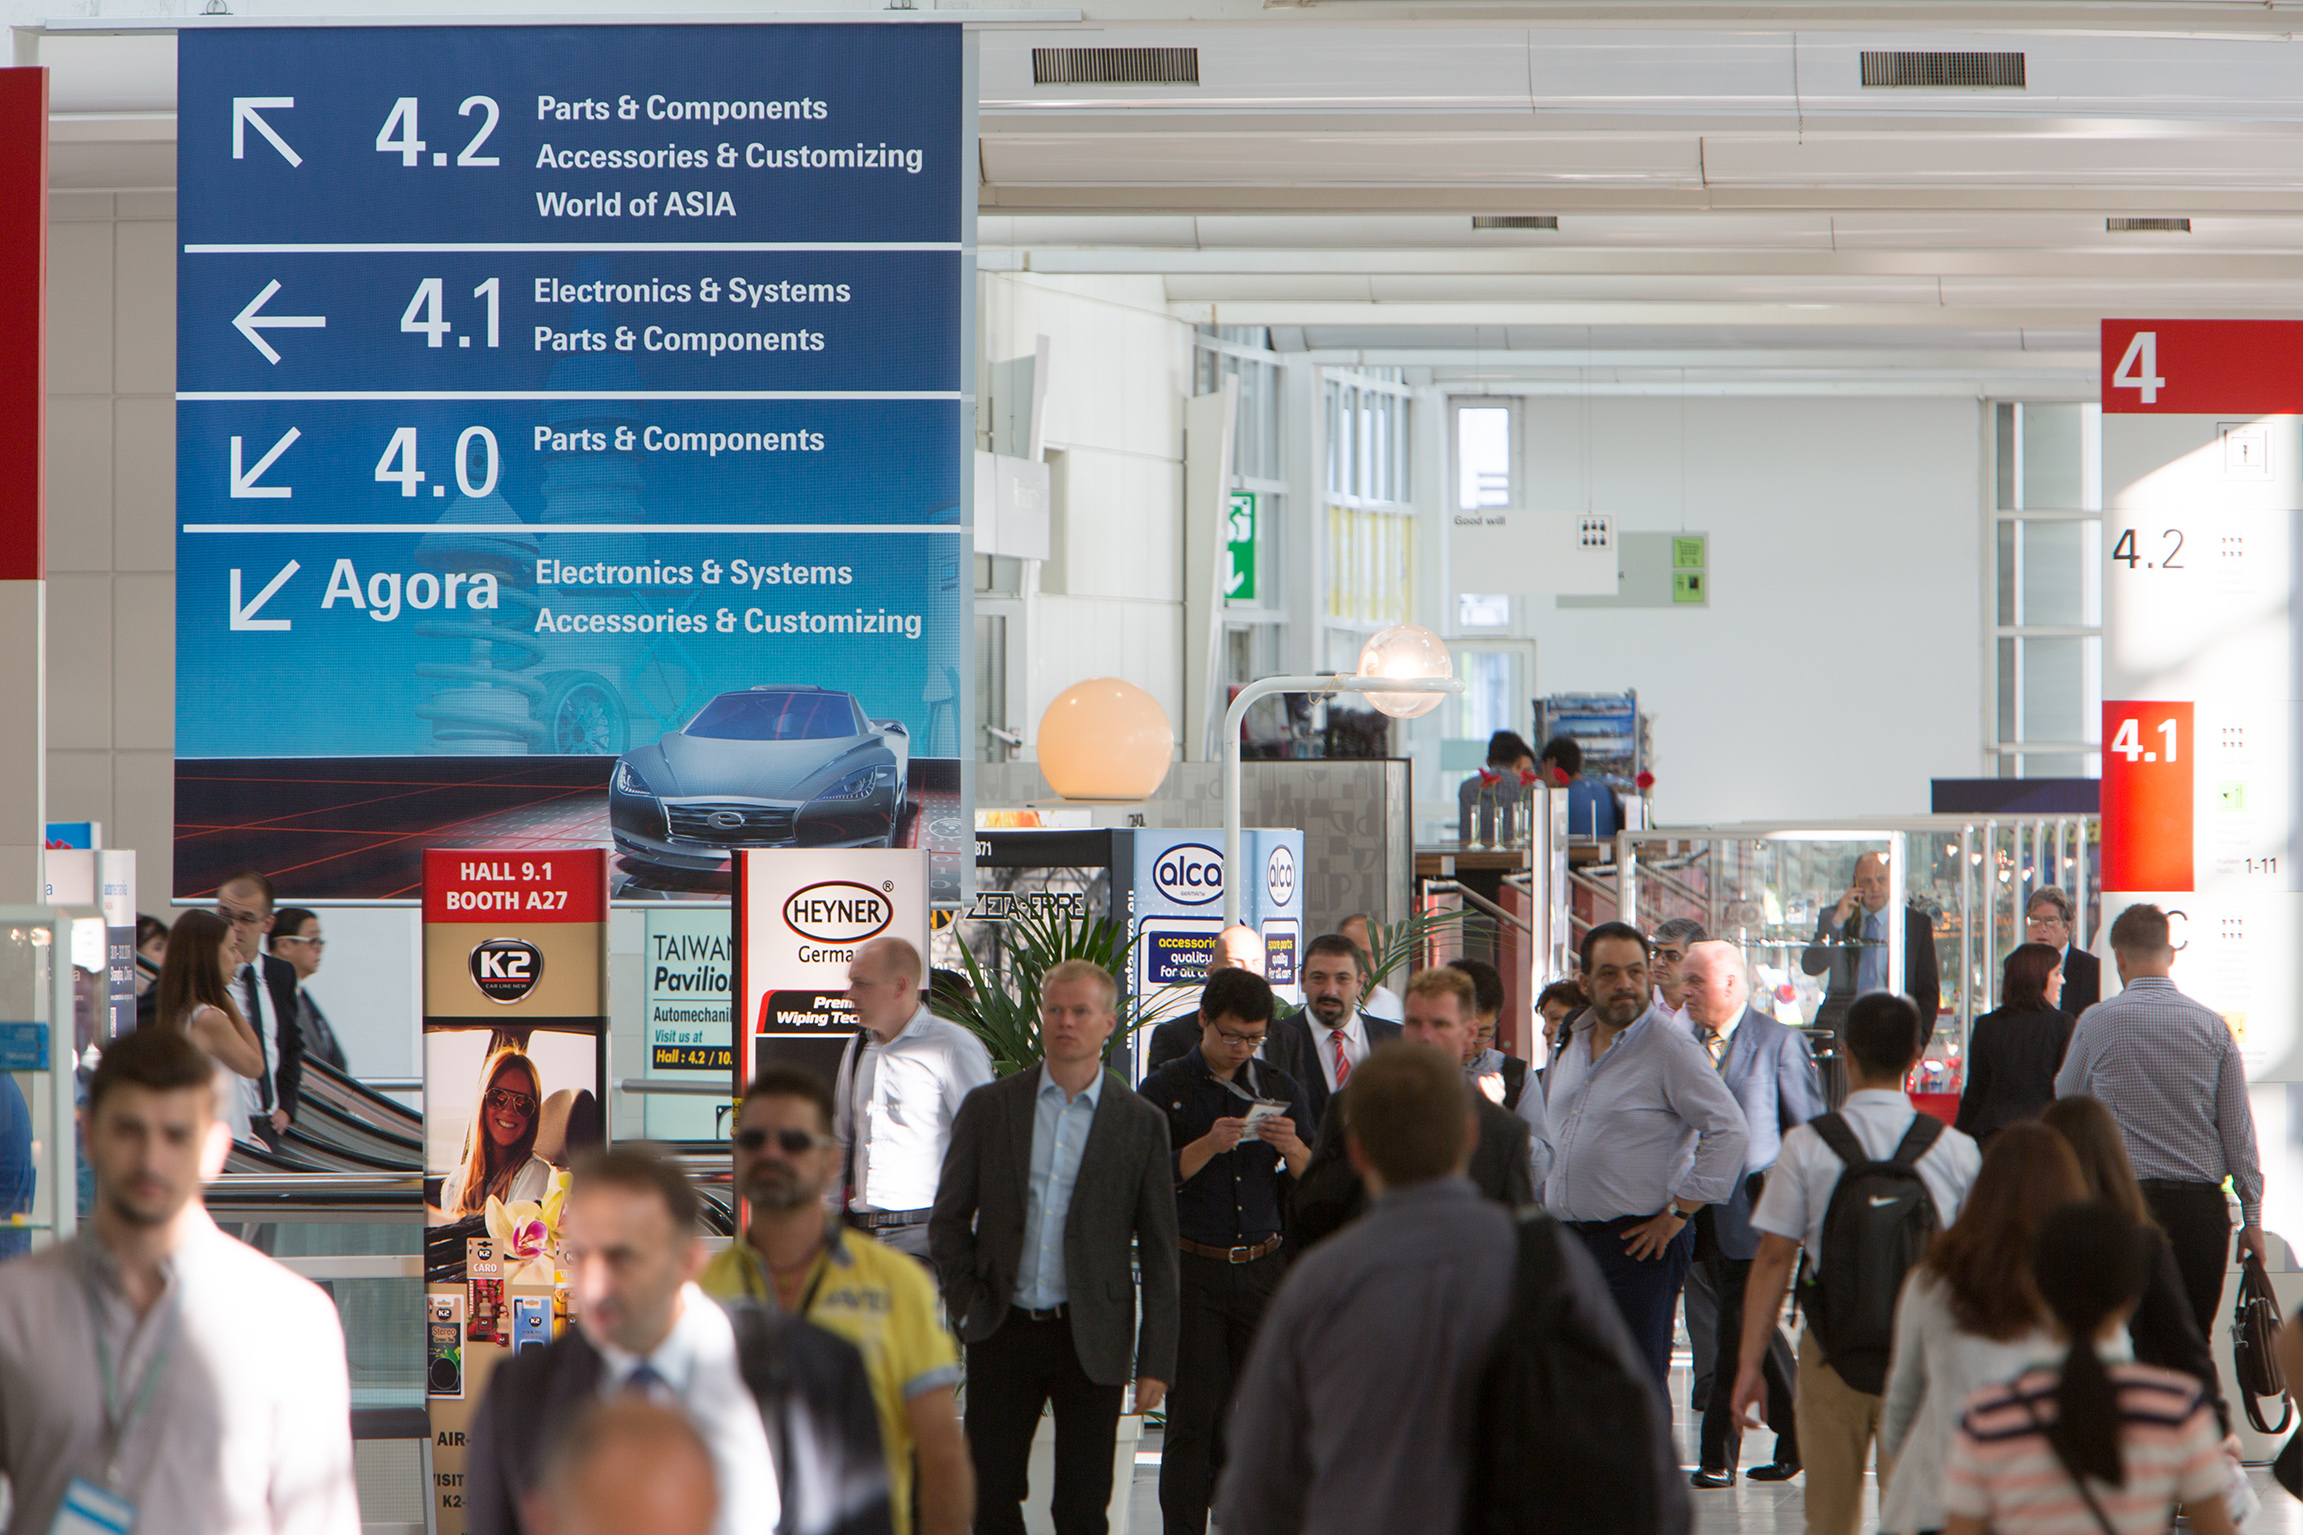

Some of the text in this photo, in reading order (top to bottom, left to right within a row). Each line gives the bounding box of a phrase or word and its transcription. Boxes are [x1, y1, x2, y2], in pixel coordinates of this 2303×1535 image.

[538, 95, 827, 125] Parts & Components
[376, 96, 499, 166] 4.2
[536, 143, 922, 173] Accessories & Customizing
[536, 192, 736, 216] World of ASIA
[535, 278, 850, 308] Electronics & Systems
[401, 278, 499, 347] 4.1
[535, 326, 824, 356] Parts & Components
[2113, 331, 2166, 404] 4
[535, 426, 824, 456] Parts & Components
[375, 426, 498, 498] 4.0
[1454, 514, 1506, 526] Good will
[2113, 528, 2184, 569] 4.2
[537, 559, 852, 590] Electronics & Systems
[321, 559, 498, 622] Agora
[535, 608, 921, 639] Accessories & Customizing
[2111, 718, 2178, 763] 4.1
[460, 862, 553, 881] HALL 9.1
[1160, 855, 1222, 887] alca
[1269, 857, 1292, 887] alca
[2245, 857, 2277, 874] 1-11
[446, 891, 568, 910] BOOTH A27
[794, 899, 882, 923] HEYNER
[481, 951, 531, 979] K2
[798, 945, 855, 963] Germa
[1160, 966, 1176, 978] for
[777, 1011, 861, 1027] Wiping Tec
[655, 1029, 703, 1043] Visit us at
[656, 1049, 679, 1063] Hall
[688, 1050, 706, 1065] 4.2
[473, 1263, 498, 1273] CARO
[432, 1326, 457, 1337] Stereo
[433, 1473, 464, 1487] ISIT
